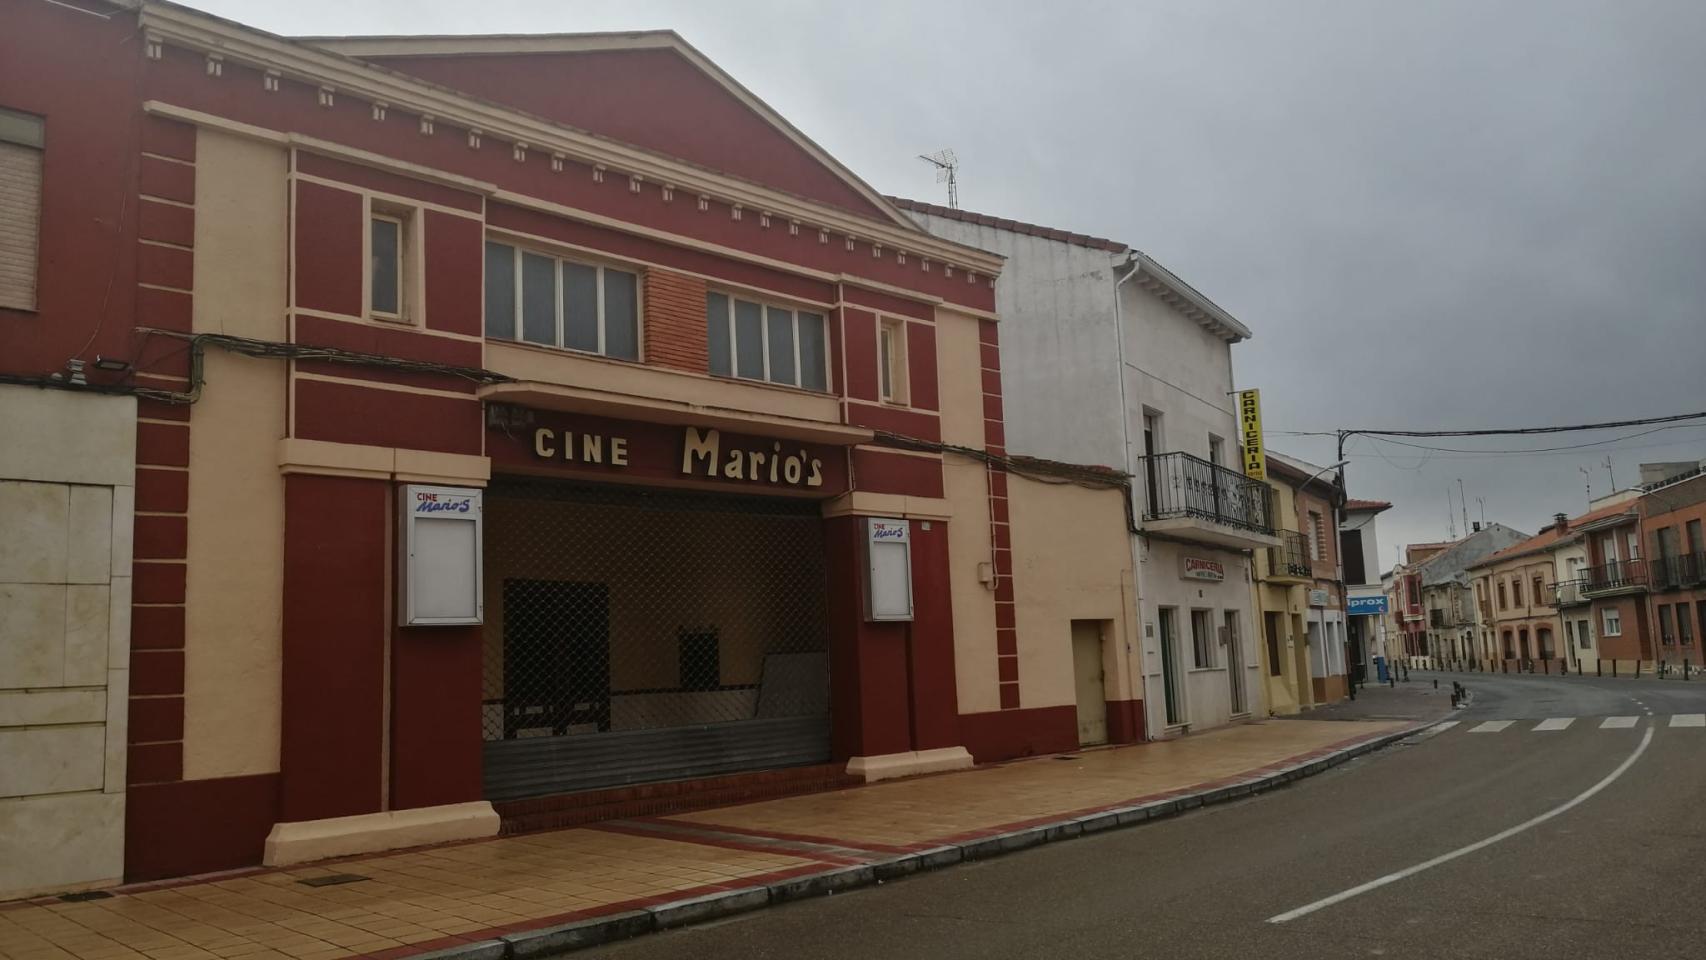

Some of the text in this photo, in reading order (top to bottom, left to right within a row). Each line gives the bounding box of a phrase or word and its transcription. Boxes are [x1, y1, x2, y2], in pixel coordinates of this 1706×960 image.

[1242, 391, 1260, 470] CARNICERIA
[535, 427, 822, 487] CINE Mario's
[416, 492, 438, 502] CINE
[1185, 558, 1224, 575] CARNICERIA
